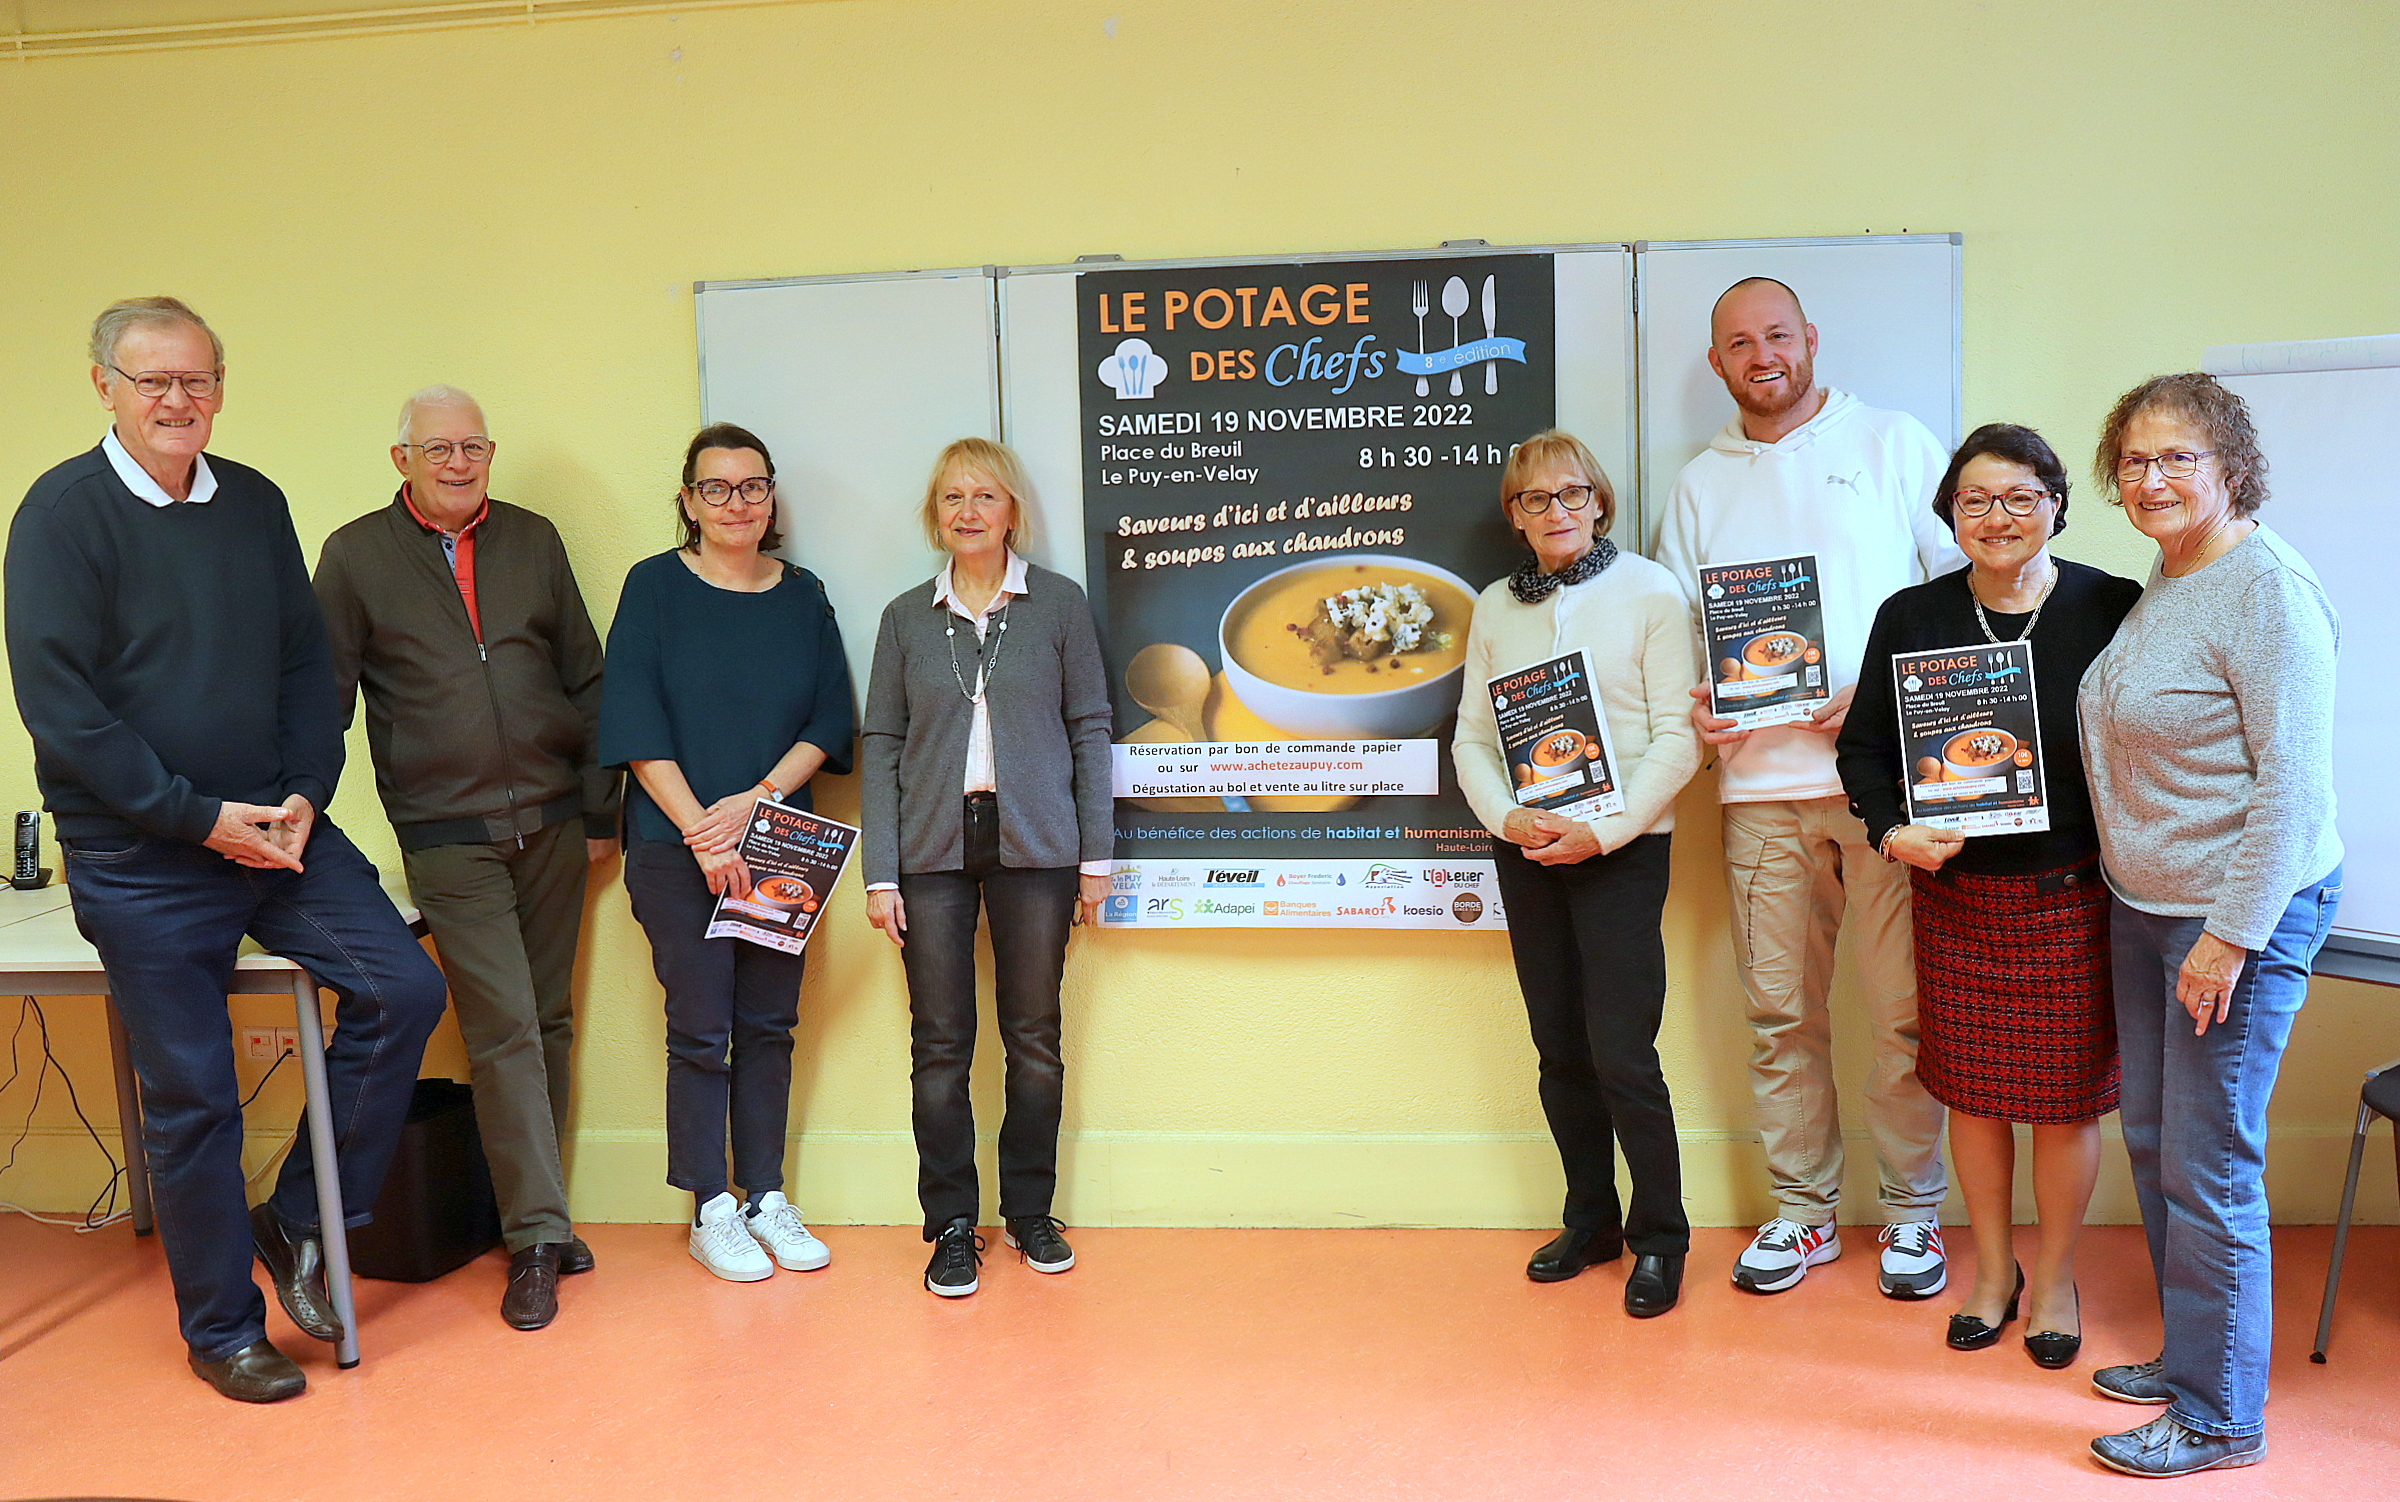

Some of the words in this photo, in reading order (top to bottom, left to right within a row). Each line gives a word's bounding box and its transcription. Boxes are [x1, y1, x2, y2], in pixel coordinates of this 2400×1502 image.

[1100, 292, 1146, 333] LE
[1164, 283, 1369, 330] POTAGE
[1191, 349, 1257, 381] DES
[1265, 335, 1386, 394] Chefs
[1425, 356, 1433, 368] 8
[1454, 344, 1510, 364] édition
[1099, 412, 1201, 436] SAMEDI
[1211, 411, 1239, 432] 19
[1248, 406, 1404, 431] NOVEMBRE
[1413, 404, 1472, 427] 2022
[1101, 445, 1154, 461] Place
[1160, 443, 1184, 459] du
[1191, 441, 1242, 458] Breuil
[1359, 448, 1374, 468] 8
[1382, 447, 1395, 467] h
[1404, 446, 1432, 467] 30
[1488, 444, 1501, 464] h
[1102, 469, 1123, 485] Le
[1129, 465, 1259, 487] Puy-en-Velay
[1118, 514, 1206, 537] Saveurs
[1213, 502, 1259, 528] d'ici
[1266, 501, 1287, 522] et
[1294, 493, 1412, 519] d'ailleurs
[1121, 549, 1137, 569] &
[1144, 544, 1225, 568] soupes
[1232, 539, 1277, 559] aux
[1283, 527, 1404, 554] chaudrons
[1706, 572, 1719, 583] LE
[1722, 567, 1772, 582] POTAGE
[1729, 585, 1746, 594] DES
[1747, 579, 1776, 594] Chefs
[1744, 594, 1782, 605] NOVEMBRE
[1902, 662, 1916, 675] LE
[1920, 656, 1978, 672] POTAGE
[1492, 685, 1502, 696] LE
[1504, 669, 1547, 692] POTAGE
[1928, 676, 1947, 686] DES
[1949, 669, 1982, 686] Chefs
[1511, 691, 1526, 701] DES
[1526, 680, 1552, 698] Chefs
[1905, 694, 1933, 703] SAMEDI
[1945, 686, 1989, 698] NOVEMBRE
[1130, 745, 1202, 755] Réservation
[1209, 746, 1228, 756] par
[1236, 744, 1258, 754] bon
[1266, 744, 1280, 753] de
[1288, 743, 1355, 752] commande
[1363, 742, 1402, 754] papier
[1180, 764, 1198, 772] sur
[1210, 760, 1362, 772] www.achetezaupuy.com
[1132, 784, 1205, 795] Dégustation
[1228, 782, 1246, 792] bol
[1265, 783, 1300, 791] vente
[1321, 781, 1346, 791] litre
[1350, 783, 1368, 791] sur
[1372, 781, 1404, 793] place
[759, 808, 772, 819] LE
[773, 812, 818, 833] POTAGE
[774, 826, 790, 837] DES
[790, 831, 816, 845] Chefs
[1114, 828, 1133, 839] Au
[1137, 827, 1205, 839] bénéfice
[1210, 827, 1236, 839] des
[1241, 827, 1296, 839] actions
[1301, 827, 1322, 838] de
[1326, 826, 1380, 838] habitat
[1385, 827, 1400, 838] et
[1214, 903, 1255, 915] Adapei
[1404, 905, 1443, 915] koesio
